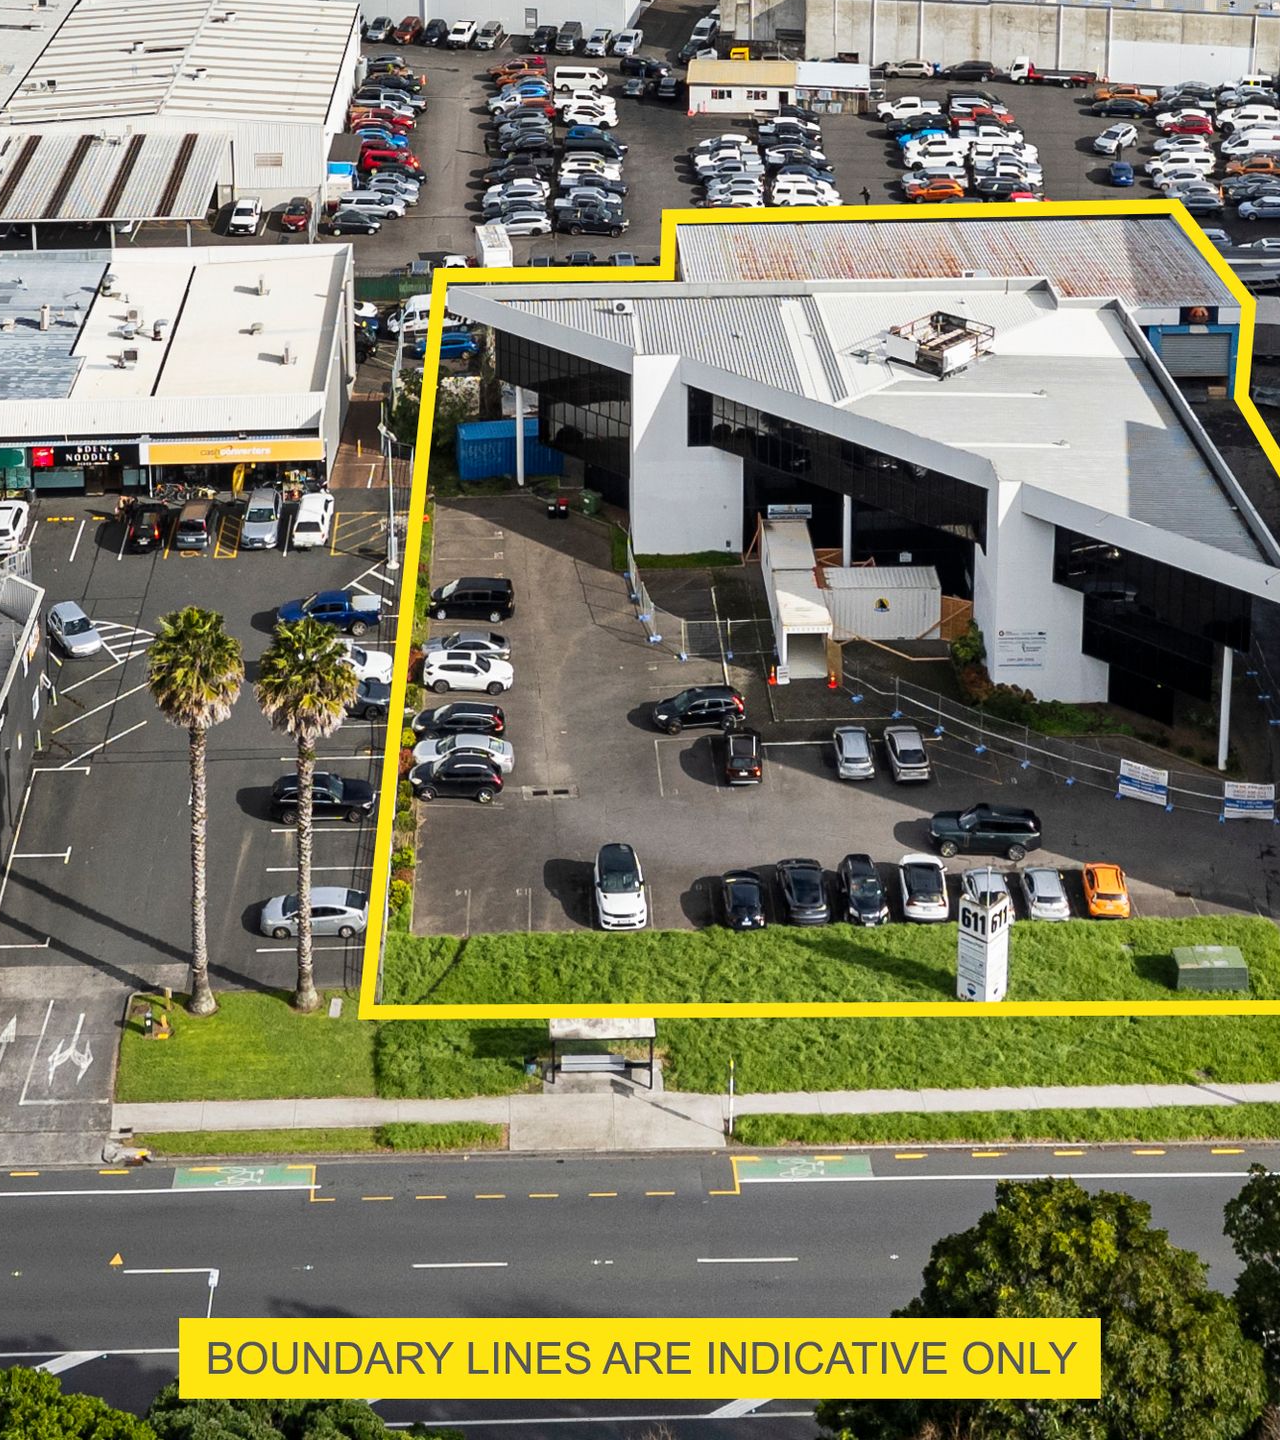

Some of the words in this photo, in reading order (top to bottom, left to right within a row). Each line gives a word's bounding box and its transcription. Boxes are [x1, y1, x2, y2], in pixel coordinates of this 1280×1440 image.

[65, 452, 120, 462] NOODLES
[962, 907, 986, 936] 611
[991, 905, 1008, 934] 611
